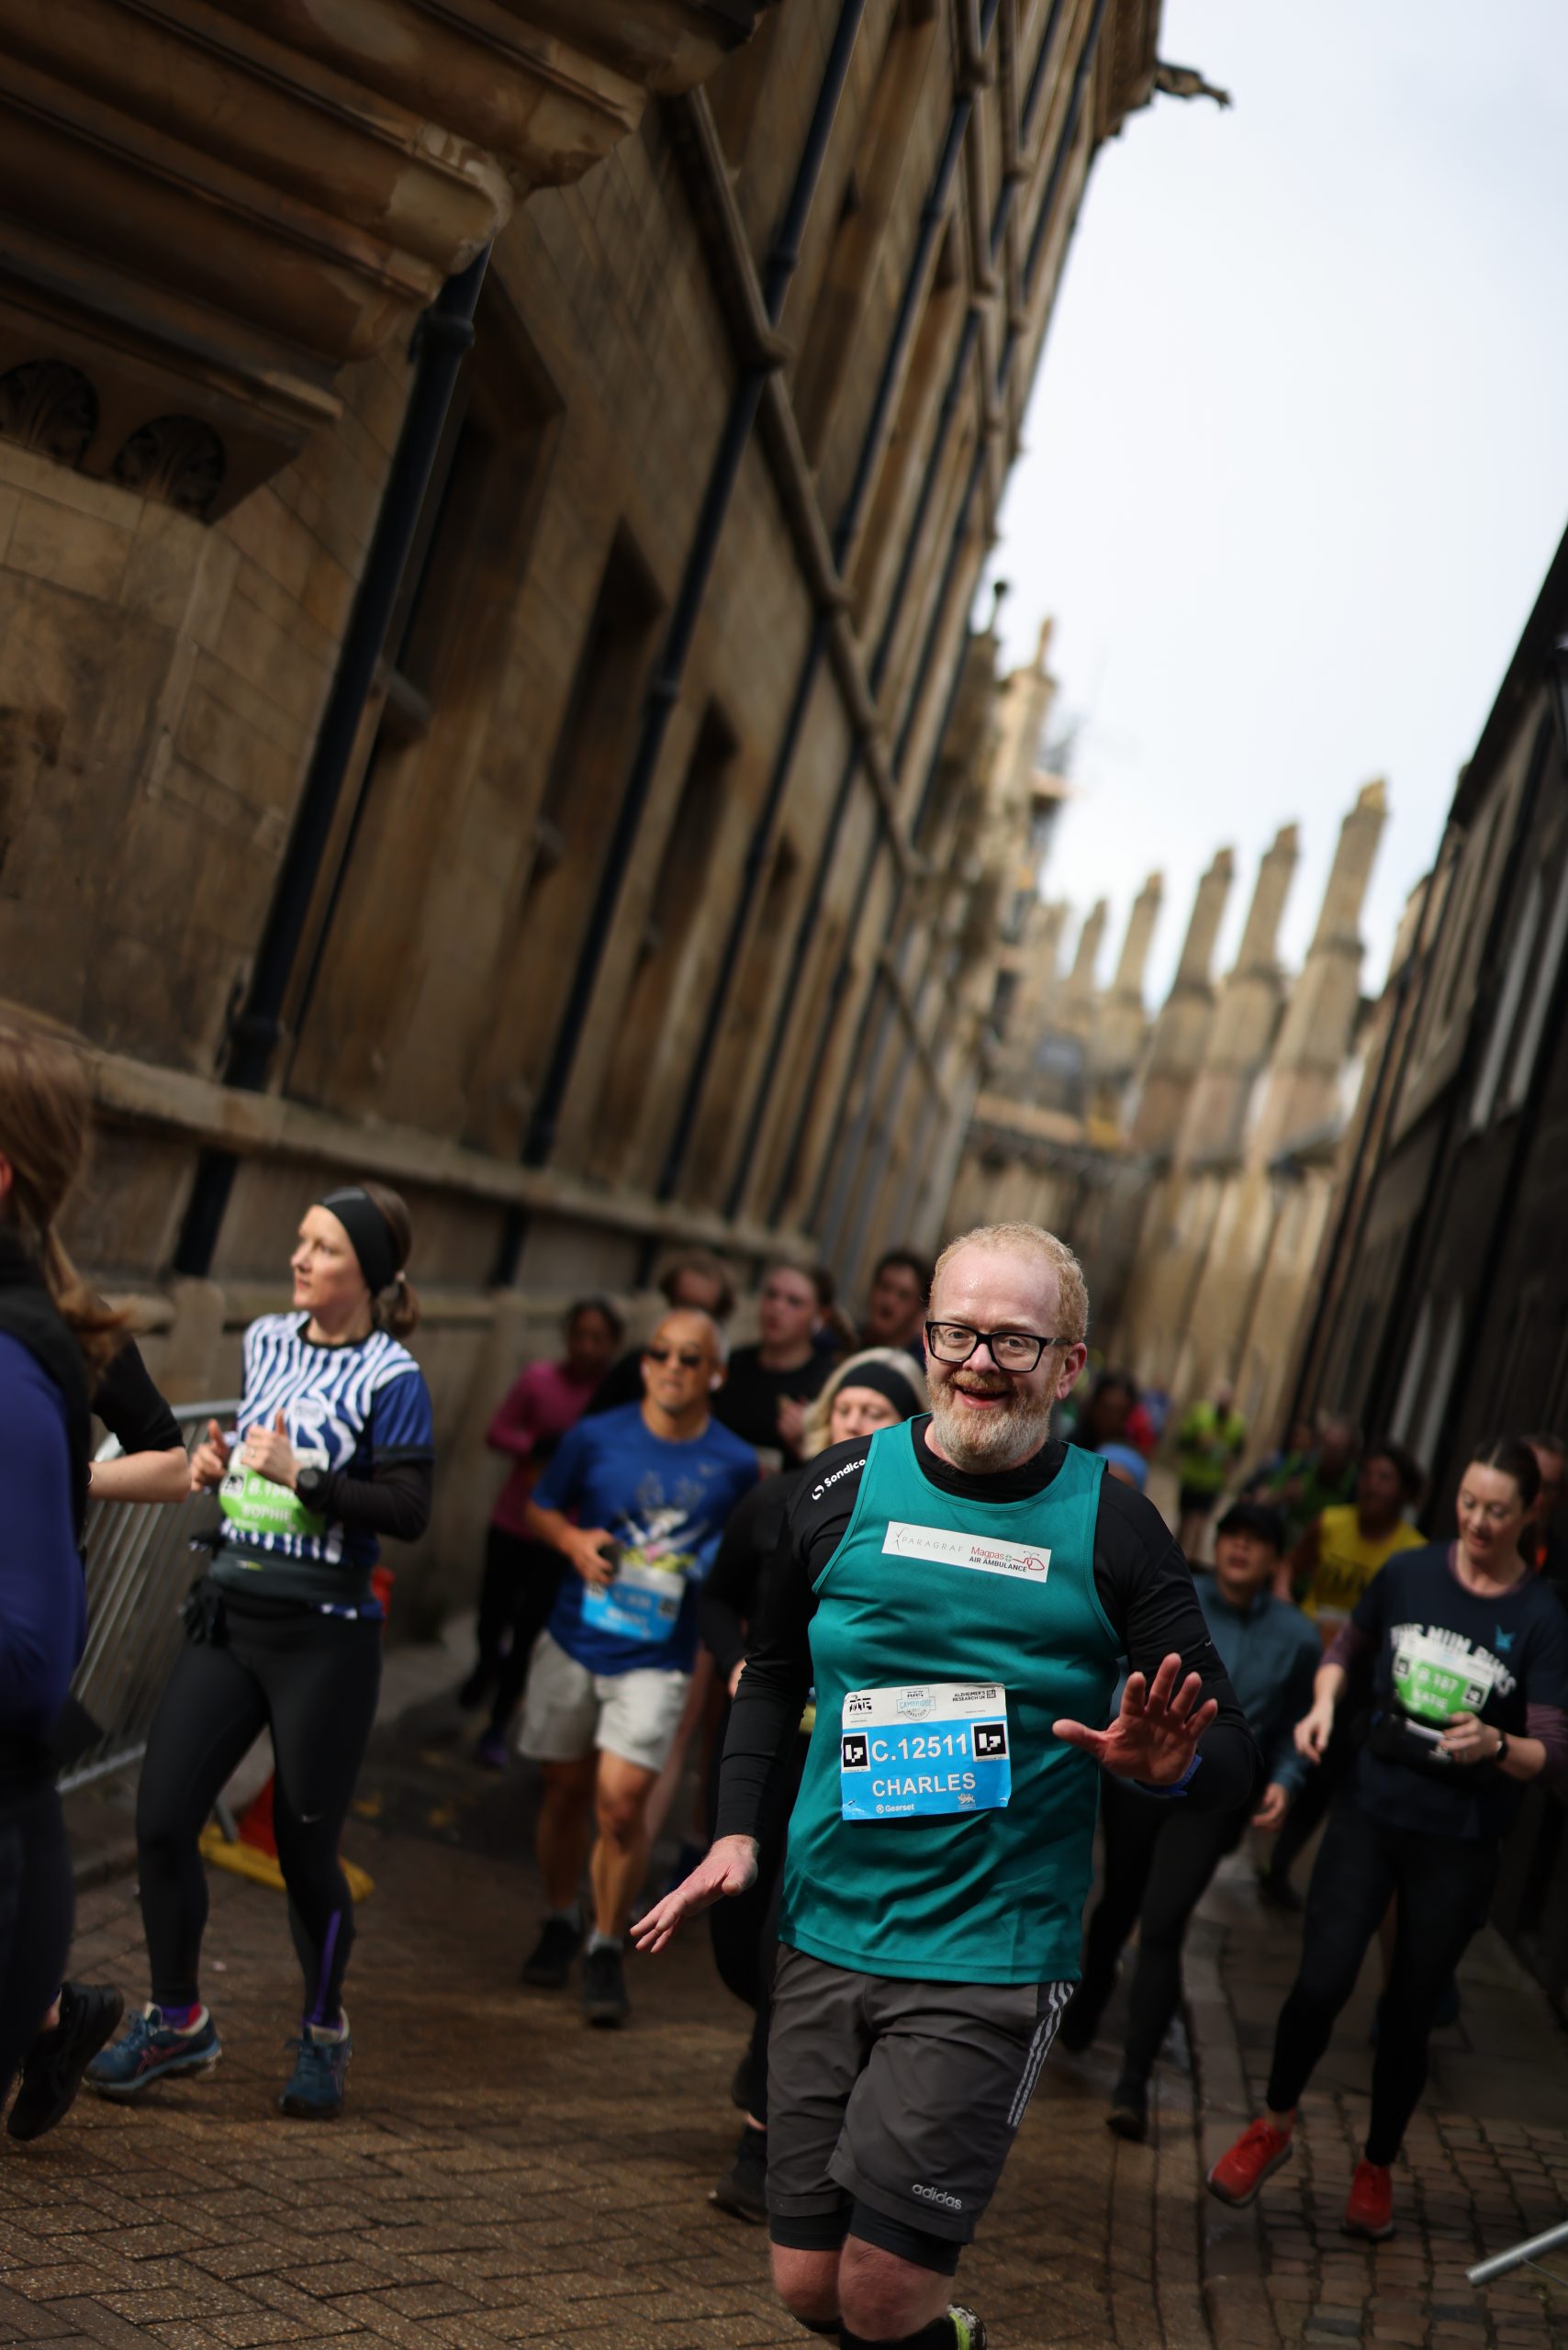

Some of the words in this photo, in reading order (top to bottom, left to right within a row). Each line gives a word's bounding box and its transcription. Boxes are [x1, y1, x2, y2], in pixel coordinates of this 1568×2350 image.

[824, 1459, 866, 1487] Sondico
[902, 1536, 963, 1552] PARAGRAF
[970, 1546, 1004, 1560] Magpas
[969, 1556, 981, 1564] AIR
[983, 1558, 1027, 1572] AMBULANCE
[899, 1699, 933, 1709] CAMBRIDGE
[952, 1695, 978, 1703] RESEARCH
[872, 1733, 967, 1762] C.12511
[872, 1773, 976, 1797] CHARLES
[885, 1804, 915, 1812] Gearset
[912, 2184, 962, 2210] adidas
